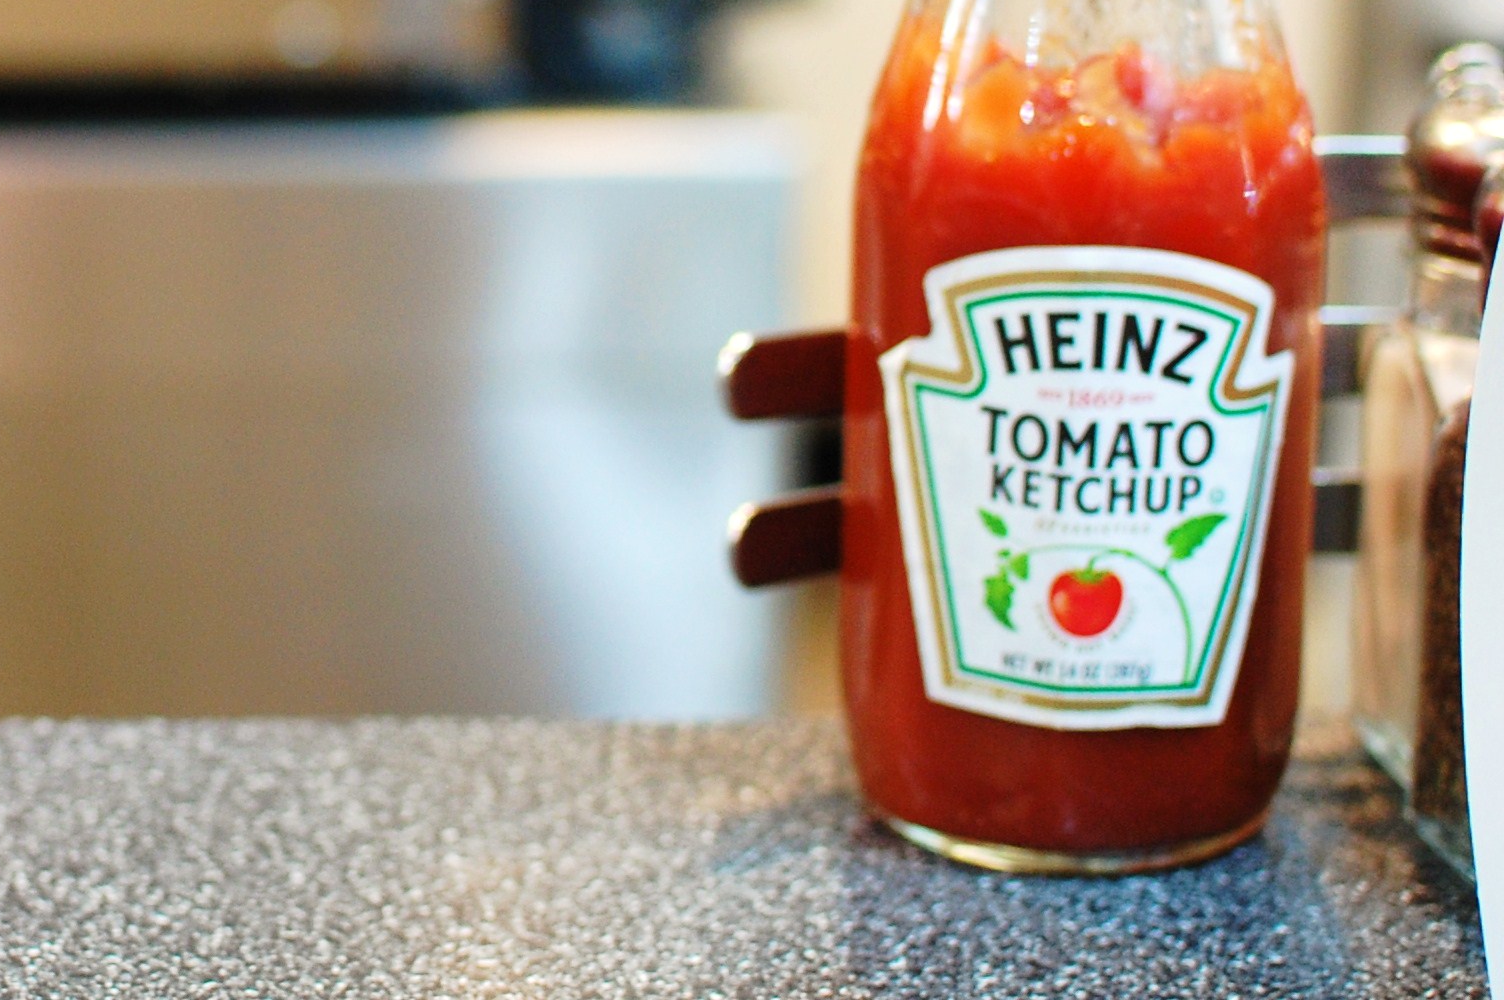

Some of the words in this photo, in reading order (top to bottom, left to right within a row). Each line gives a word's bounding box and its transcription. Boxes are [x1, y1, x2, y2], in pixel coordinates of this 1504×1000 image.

[995, 312, 1209, 384] HEINZ
[981, 406, 1215, 468] TOMATO
[990, 462, 1202, 515] KETCHUP
